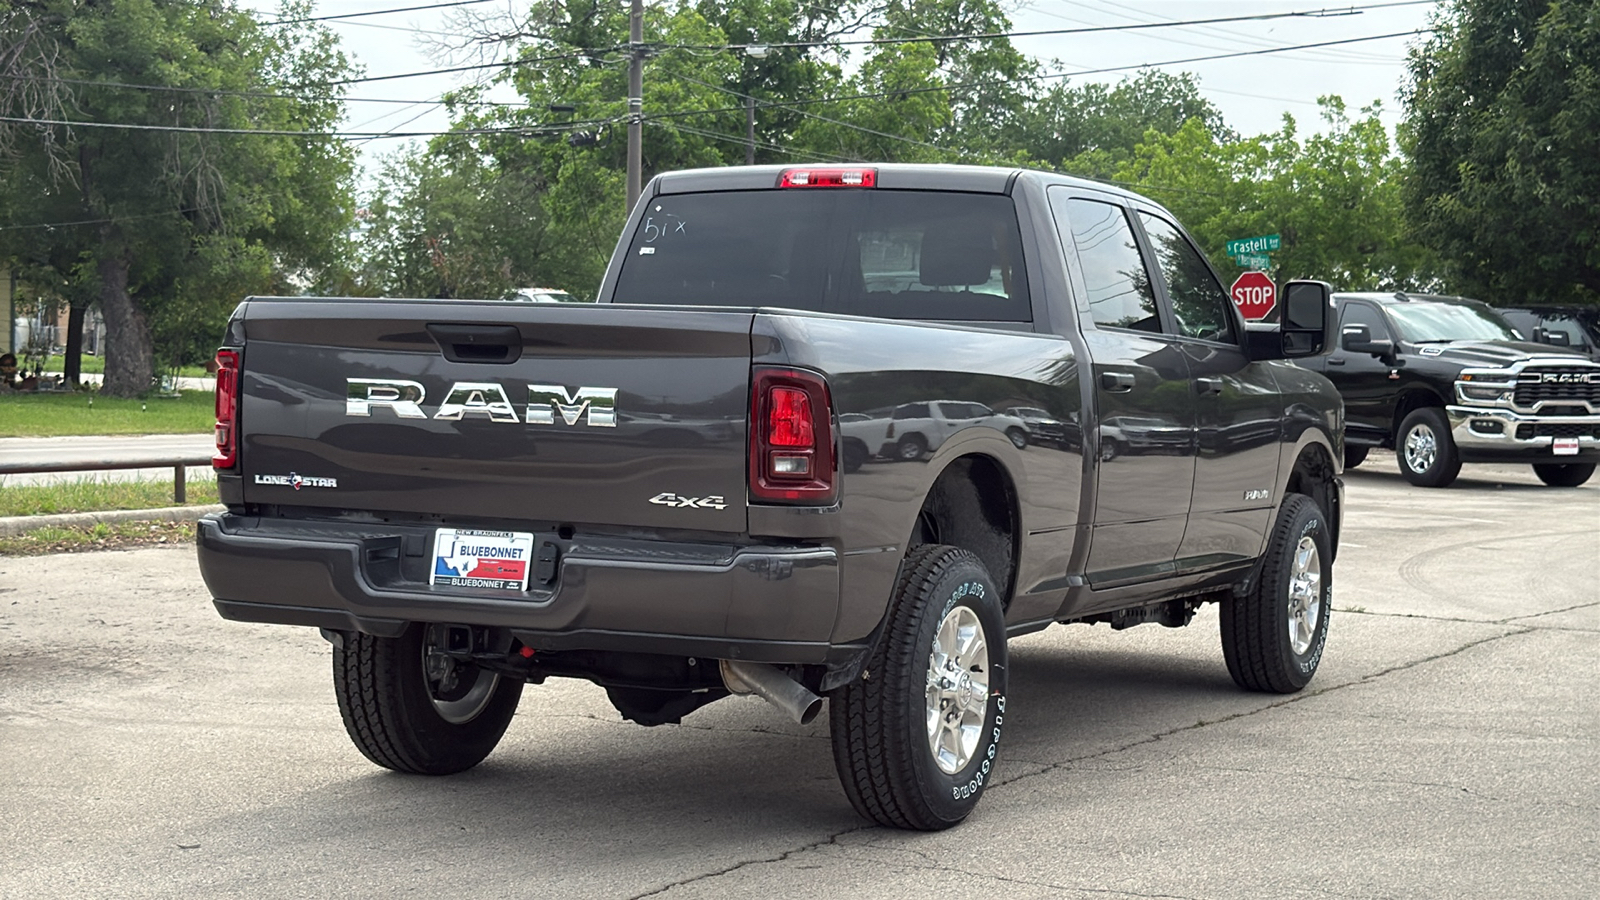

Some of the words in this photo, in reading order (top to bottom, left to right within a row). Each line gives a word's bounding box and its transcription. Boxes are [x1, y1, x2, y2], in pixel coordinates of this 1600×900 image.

[1233, 238, 1267, 253] Castell
[1234, 286, 1273, 306] STOP
[1542, 373, 1589, 383] RAM
[346, 377, 618, 427] RAM
[1243, 489, 1269, 500] RAM
[473, 530, 514, 538] BRAUNFELS
[460, 545, 524, 559] BLUEBONNET
[451, 577, 505, 589] BLUEBONNET
